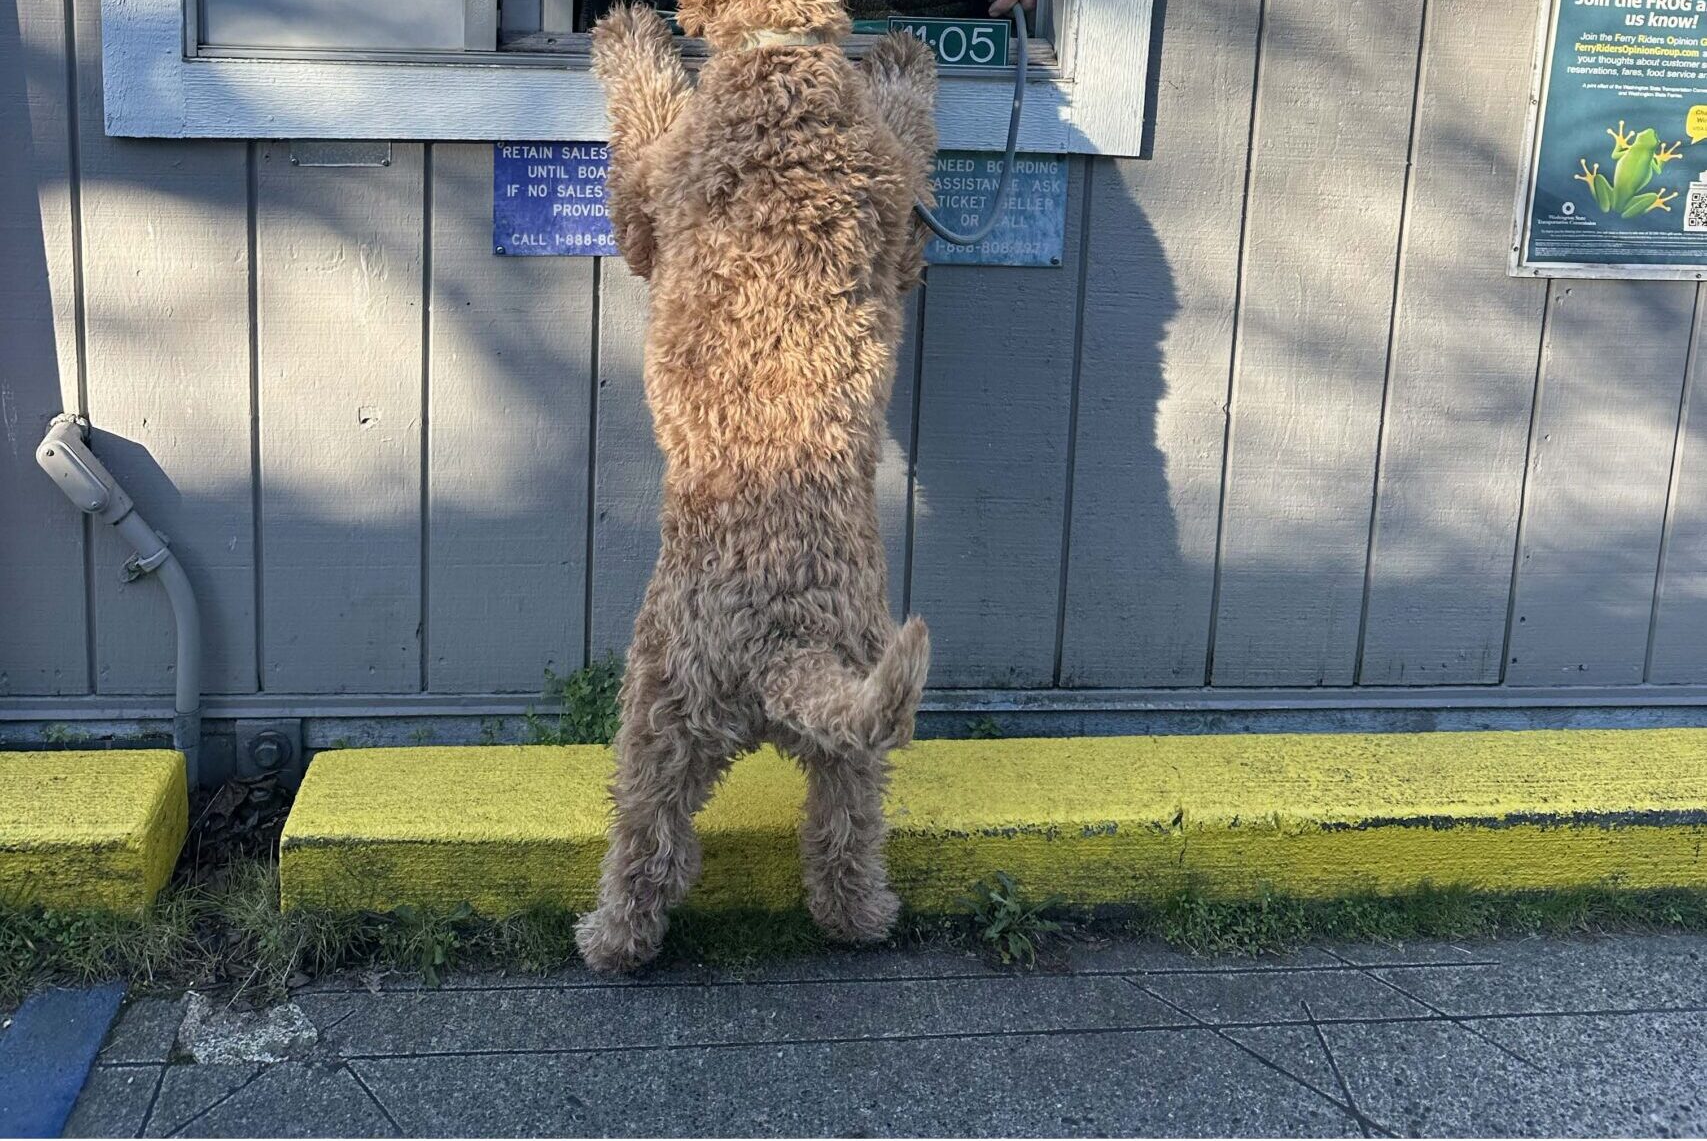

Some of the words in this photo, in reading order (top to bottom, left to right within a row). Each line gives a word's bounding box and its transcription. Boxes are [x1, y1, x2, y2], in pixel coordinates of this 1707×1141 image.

[1695, 0, 1707, 12] a
[1625, 14, 1645, 26] us
[1647, 12, 1699, 29] know!
[1580, 32, 1598, 41] Join
[1600, 33, 1613, 41] the
[1615, 33, 1636, 44] Ferry
[1638, 34, 1665, 44] Riders
[1666, 36, 1699, 46] Opinion
[1575, 42, 1700, 58] FerryRidersOpinionGroup.com
[1577, 55, 1597, 64] your
[1598, 55, 1635, 66] thoughts
[1636, 57, 1660, 66] about
[1661, 59, 1700, 68] customer
[1567, 66, 1619, 76] reservations,
[1621, 68, 1645, 77] fares,
[1646, 68, 1666, 77] food
[1667, 70, 1697, 79] service
[503, 146, 552, 159] RETAIN
[562, 147, 608, 160] SALES
[528, 165, 569, 178] UNTIL
[937, 159, 975, 172] NEED
[987, 160, 1058, 175] BORDING
[507, 184, 520, 197] IF
[528, 185, 547, 197] NO
[557, 185, 603, 197] SALES
[934, 177, 1020, 192] ASSISTANE
[1032, 180, 1061, 193] ASK
[937, 195, 987, 209] TICKET
[961, 214, 979, 227] OR
[996, 216, 1028, 228] ALL
[511, 234, 547, 246] CALL
